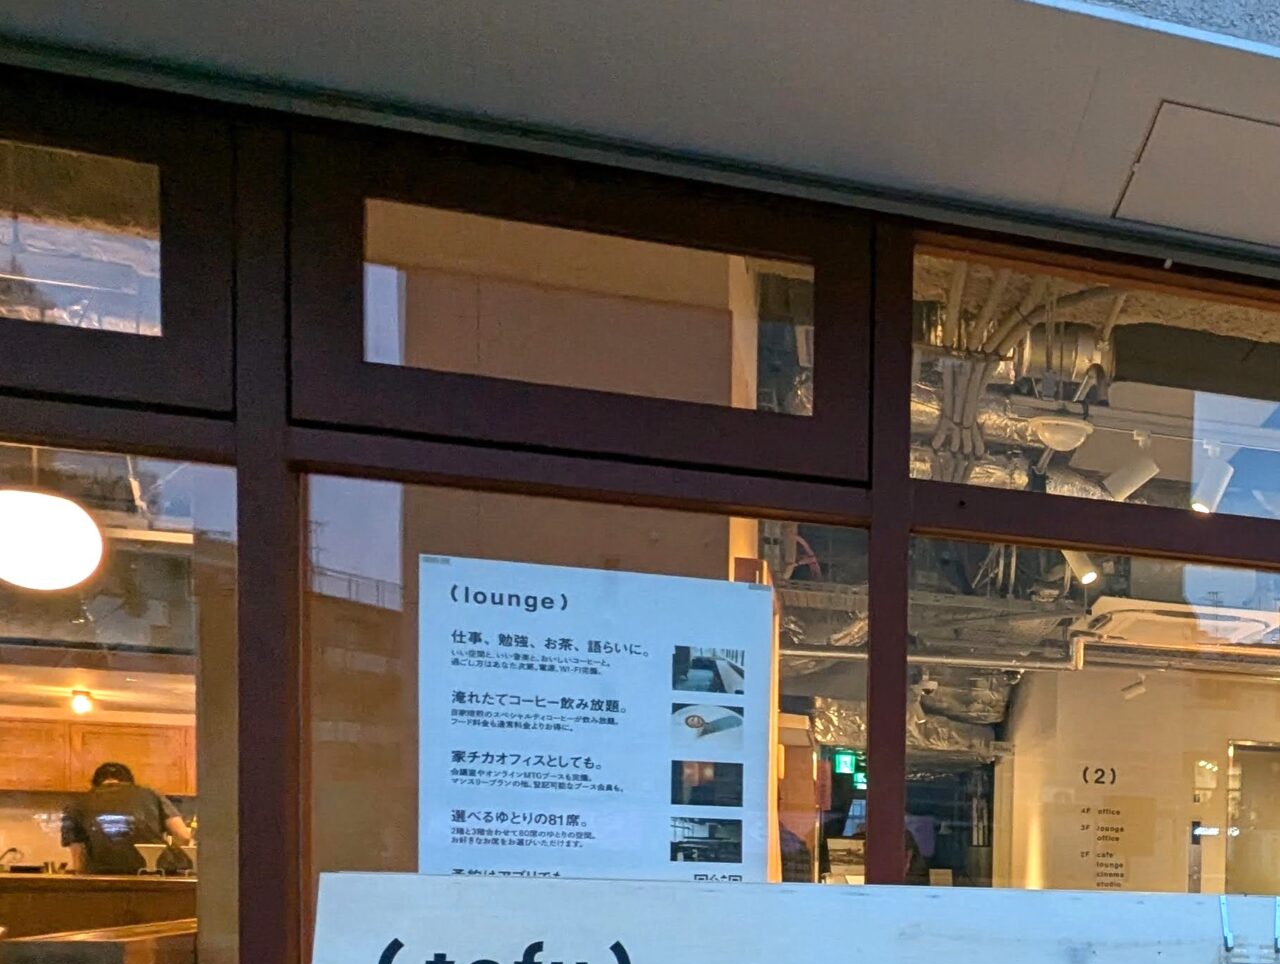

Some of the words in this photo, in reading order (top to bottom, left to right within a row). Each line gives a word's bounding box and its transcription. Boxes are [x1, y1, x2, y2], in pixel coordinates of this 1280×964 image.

[450, 584, 568, 612] (lounge)
[451, 629, 649, 657] 仕事、勉強、お茶、語らいに。
[451, 690, 626, 713] 淹れたてコーヒー飲み放題。
[451, 750, 601, 769] 家チカオフィスとしても。
[1082, 766, 1116, 785] (2)
[451, 809, 587, 827] 選べるゆとりの81席。
[1097, 808, 1121, 816] office
[1096, 825, 1124, 834] lounge
[1096, 861, 1123, 869] lounge
